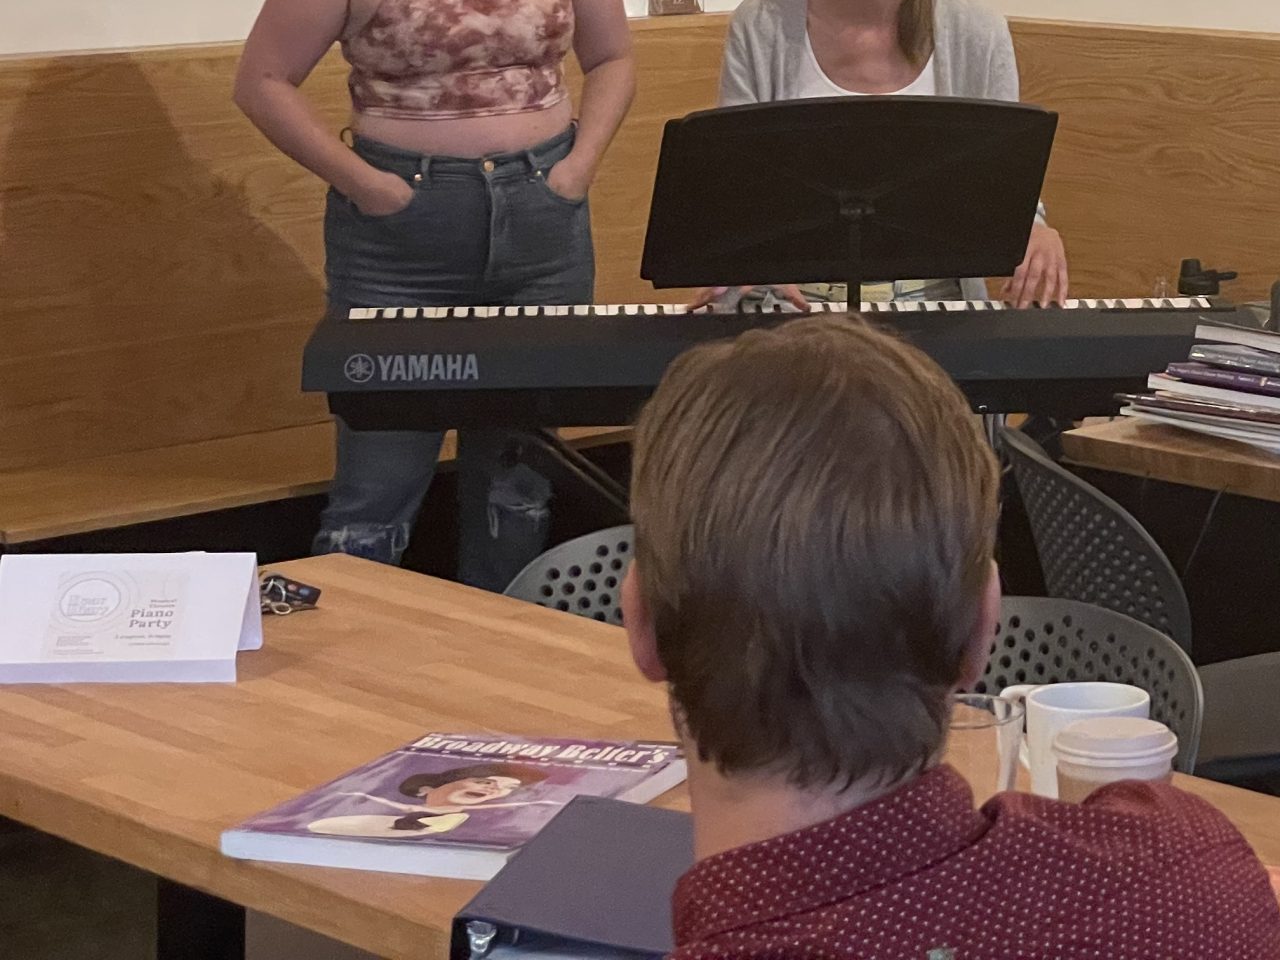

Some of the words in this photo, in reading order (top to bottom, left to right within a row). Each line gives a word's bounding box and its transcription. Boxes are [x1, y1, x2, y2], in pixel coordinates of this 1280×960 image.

[377, 353, 479, 381] YAMAHA
[130, 608, 174, 618] Piano
[129, 619, 173, 630] Party
[411, 736, 561, 759] Broadway
[555, 744, 669, 764] Belter's
